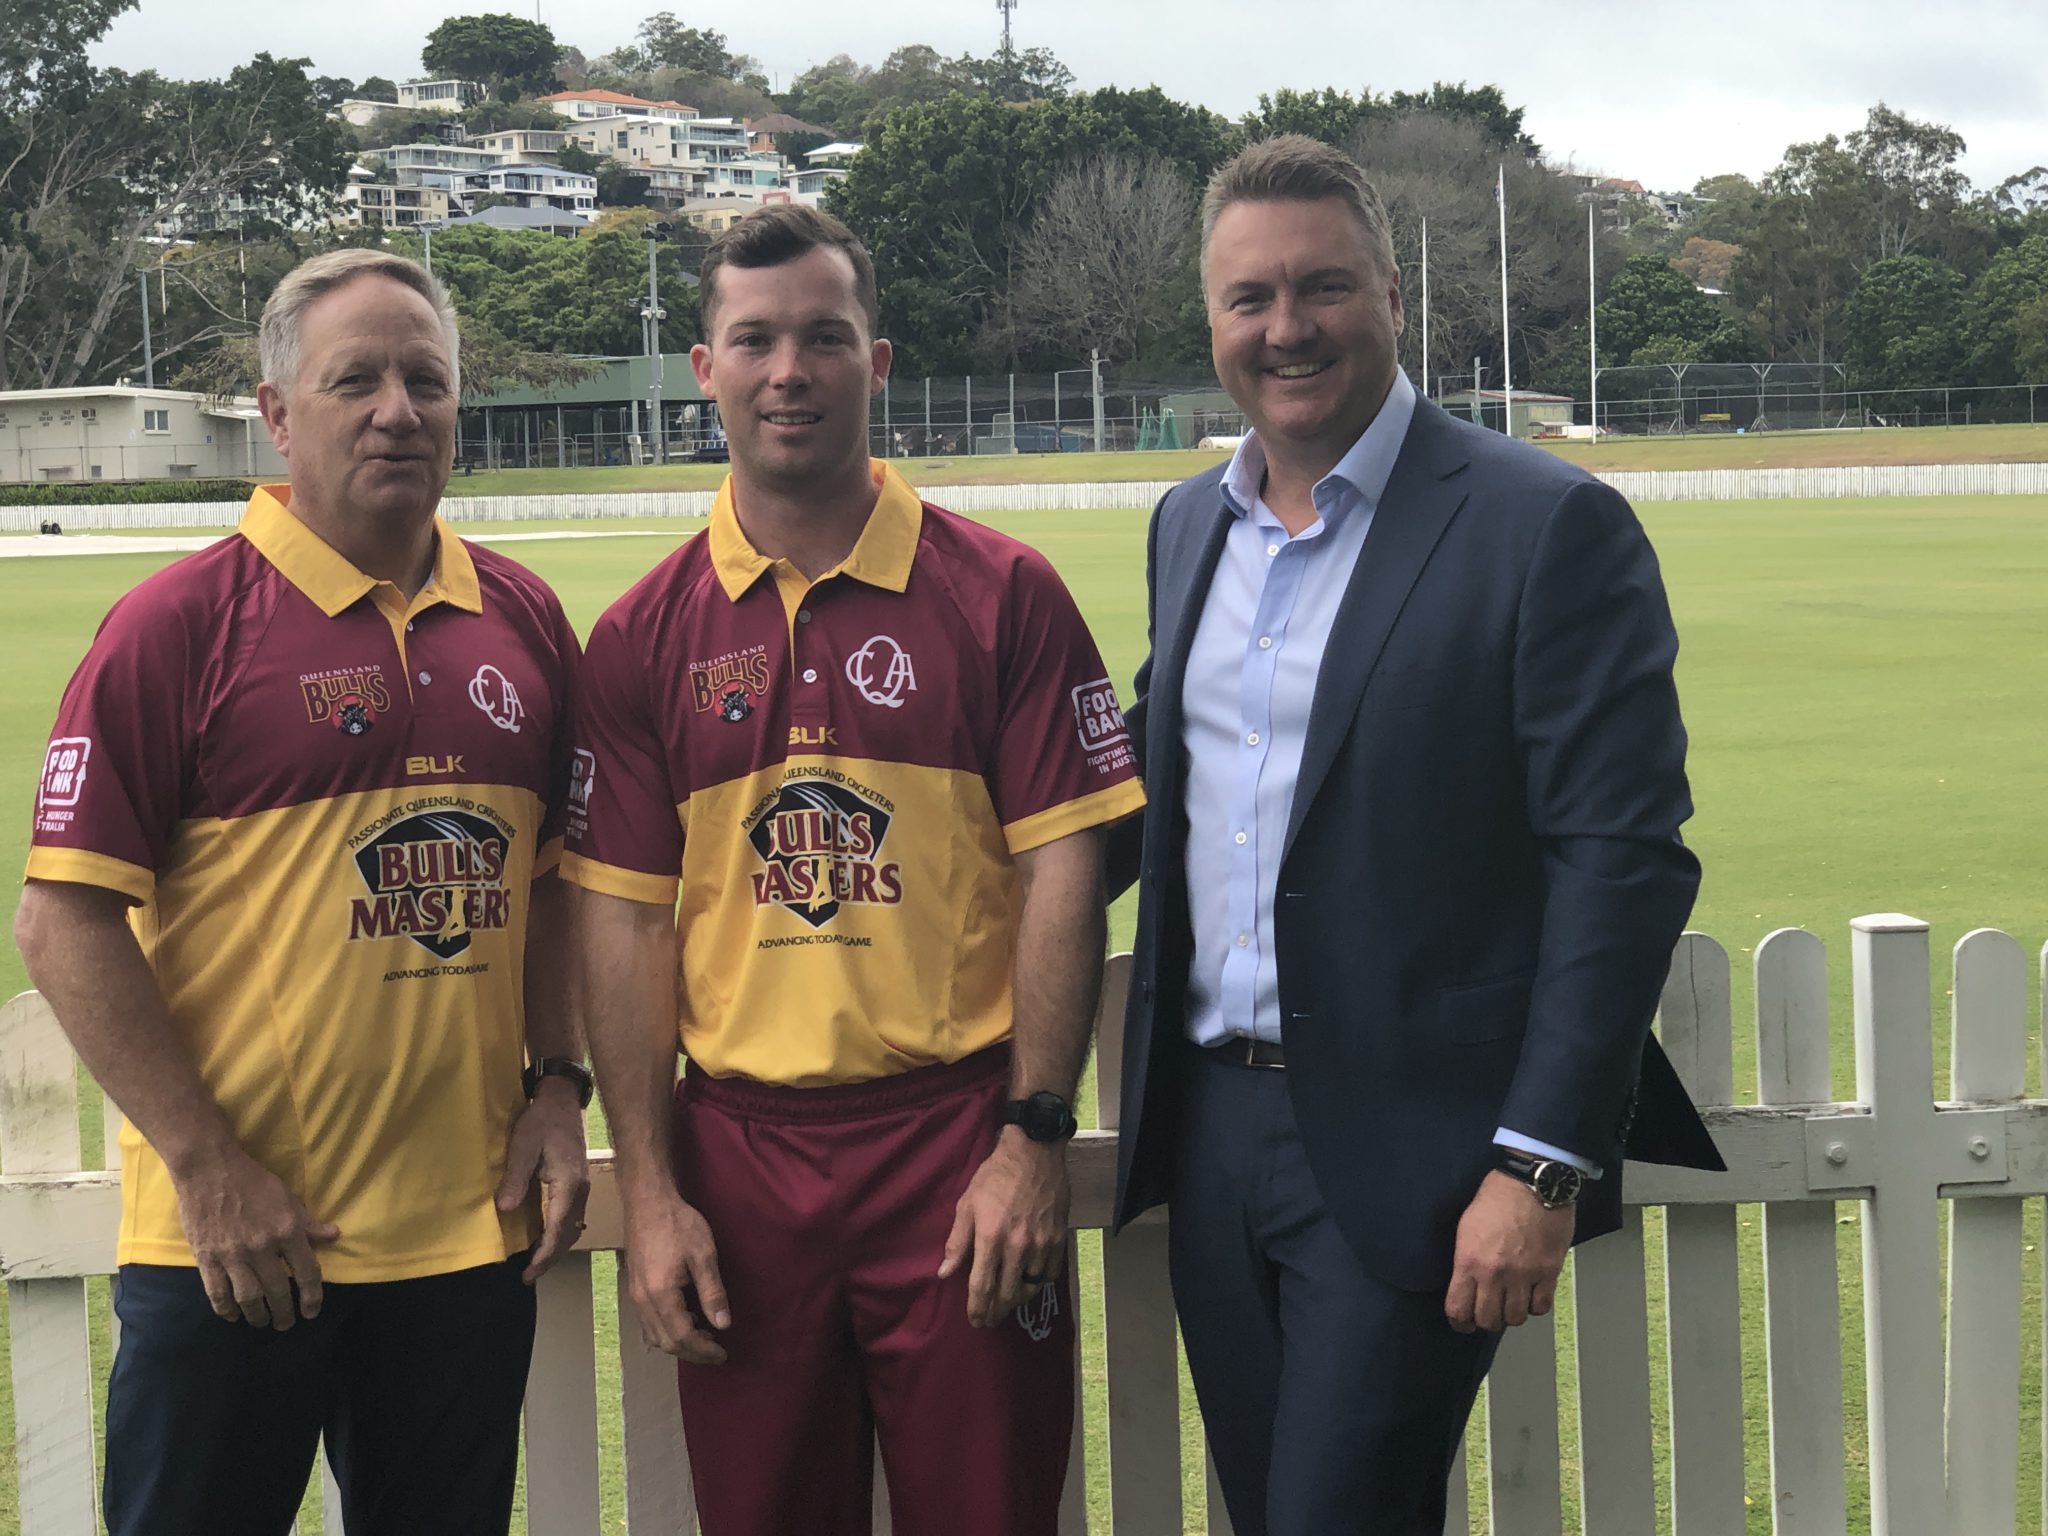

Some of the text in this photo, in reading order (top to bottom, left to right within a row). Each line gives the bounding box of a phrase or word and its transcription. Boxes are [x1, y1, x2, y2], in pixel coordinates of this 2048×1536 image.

[690, 644, 766, 670] QUEENSLAND
[299, 664, 382, 682] QUEENSLAND
[690, 653, 771, 713] BULLS
[301, 672, 391, 723] BULLS
[1082, 688, 1118, 717] FOO
[1085, 708, 1126, 738] BAN
[788, 726, 839, 746] BLK
[405, 755, 466, 775] BLK
[1086, 745, 1127, 767] FIGHTING
[783, 766, 846, 788] UEENSLAND
[1098, 764, 1110, 774] IN
[46, 811, 75, 821] HUNGER
[347, 805, 405, 849] PASSIONATE
[405, 796, 475, 812] QUEENSLAND
[376, 837, 505, 892] BULLS
[757, 935, 815, 949] ADVANCING
[383, 966, 440, 983] ADVANCING
